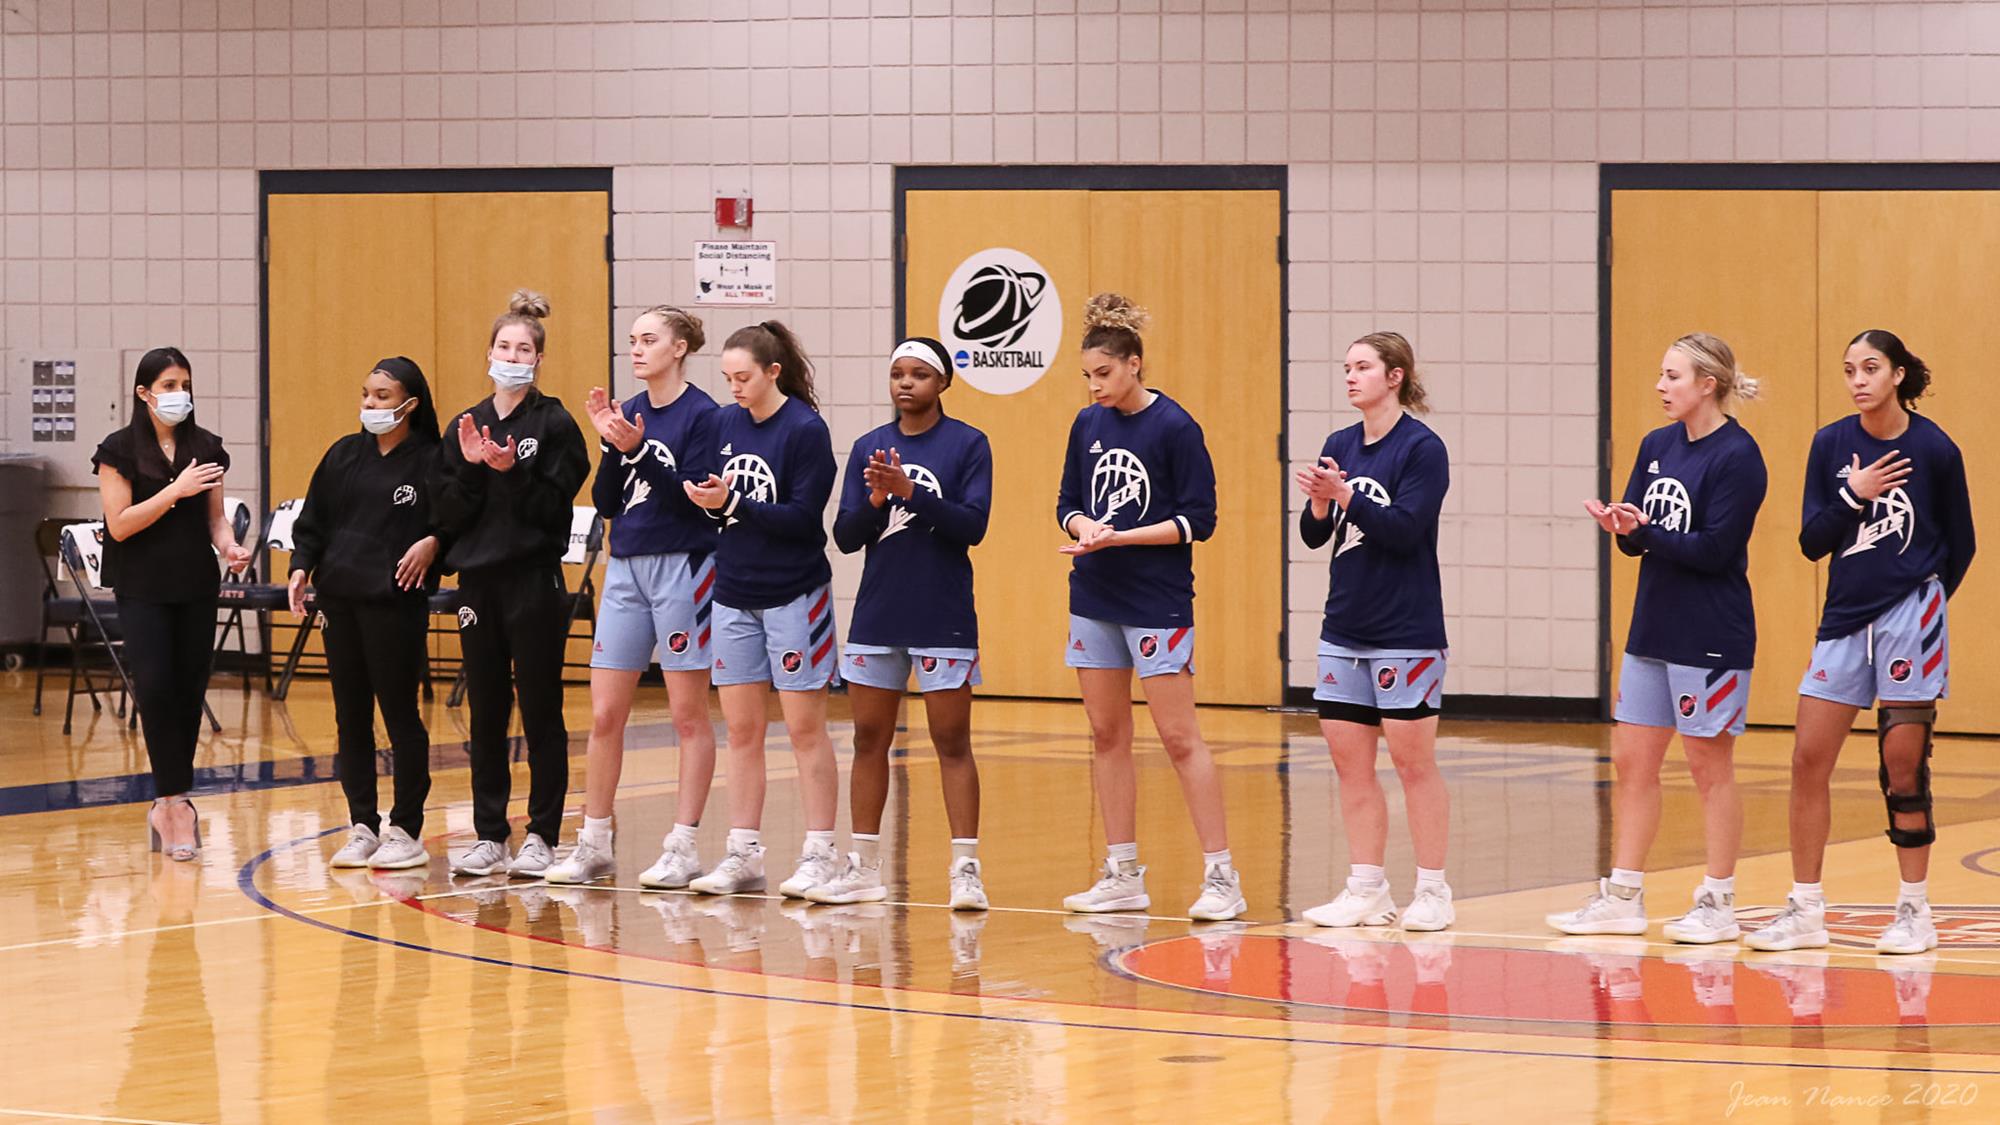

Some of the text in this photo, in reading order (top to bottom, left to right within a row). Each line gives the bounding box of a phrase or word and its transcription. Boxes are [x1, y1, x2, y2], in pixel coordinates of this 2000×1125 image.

[701, 243, 768, 251] Please Maintain
[699, 252, 771, 261] Social Distancing
[972, 350, 1044, 368] BASKETBALL
[218, 590, 245, 599] JETS
